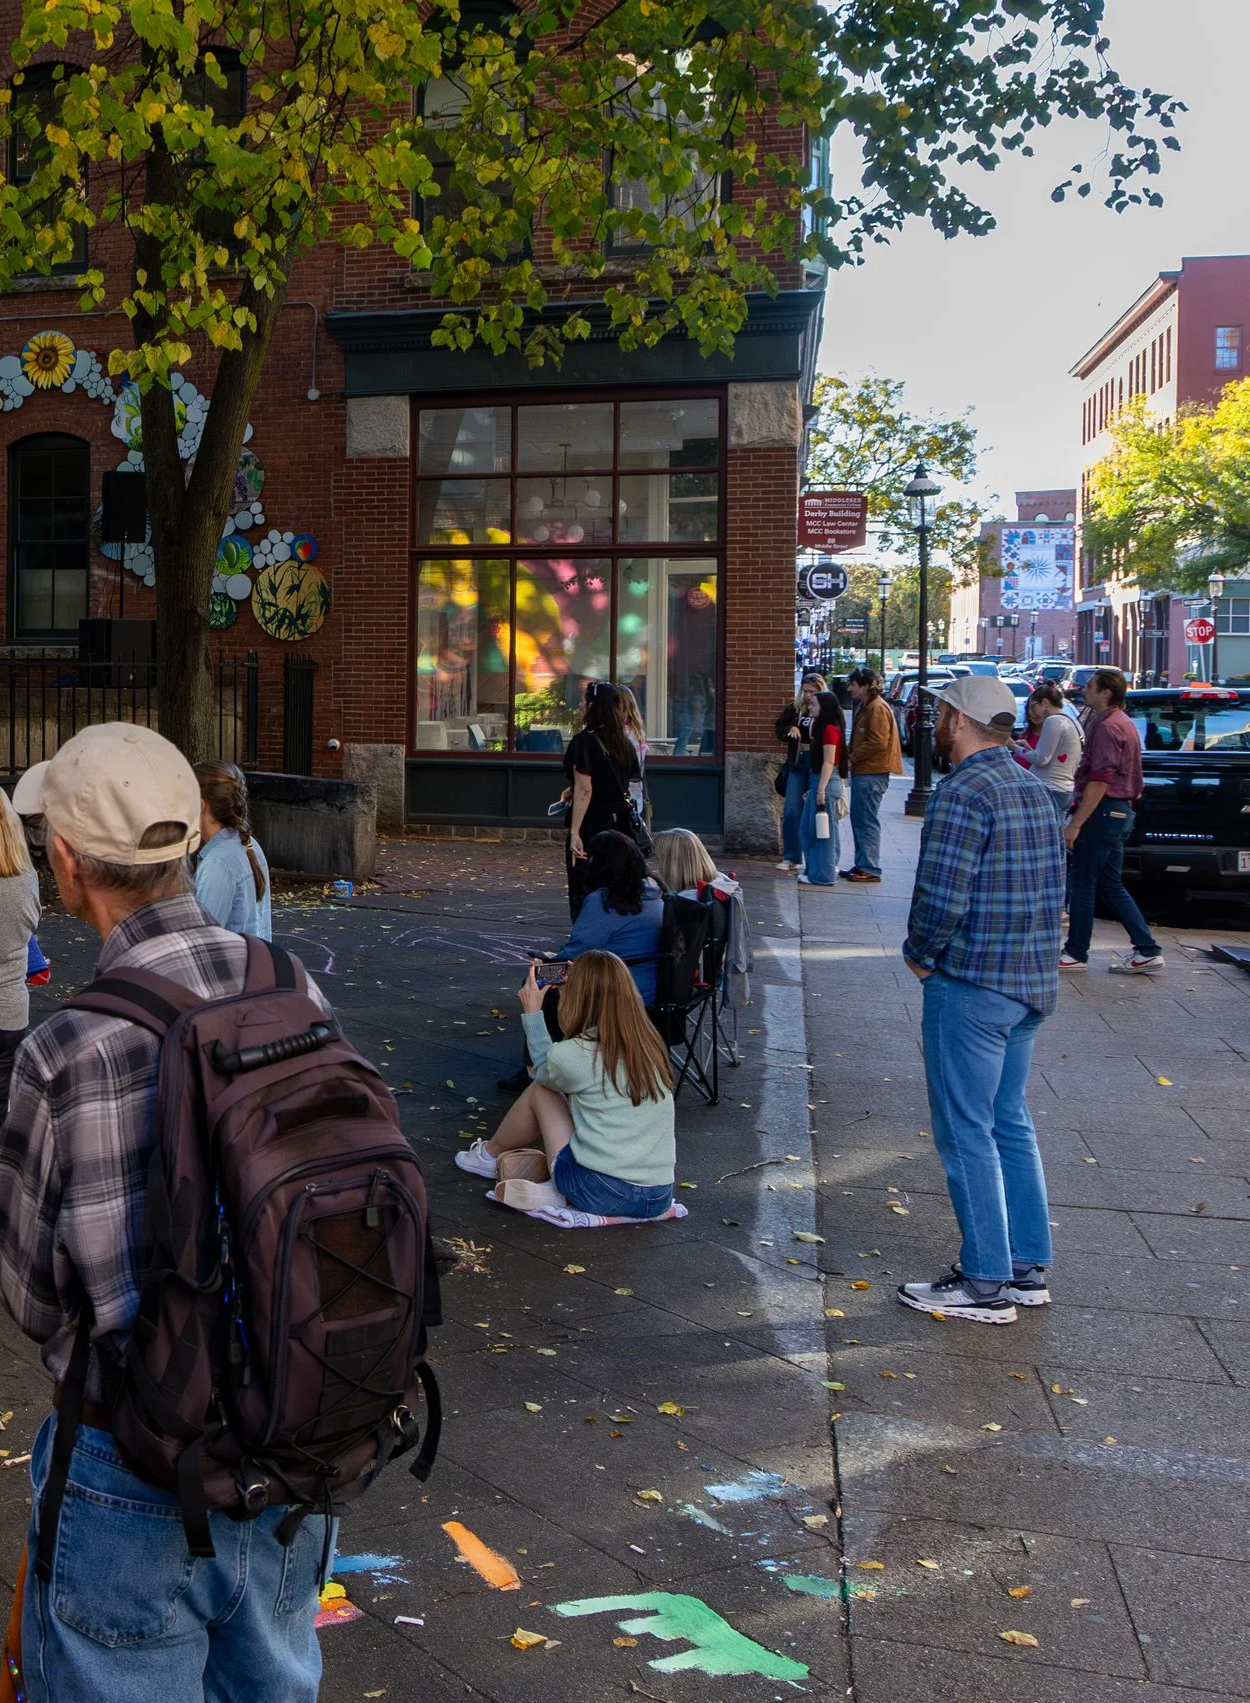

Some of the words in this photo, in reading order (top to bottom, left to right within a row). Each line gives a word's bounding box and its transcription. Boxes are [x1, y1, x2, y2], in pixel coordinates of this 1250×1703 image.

[804, 510, 827, 518] Derby
[829, 510, 861, 518] Building
[1186, 626, 1213, 637] STOP
